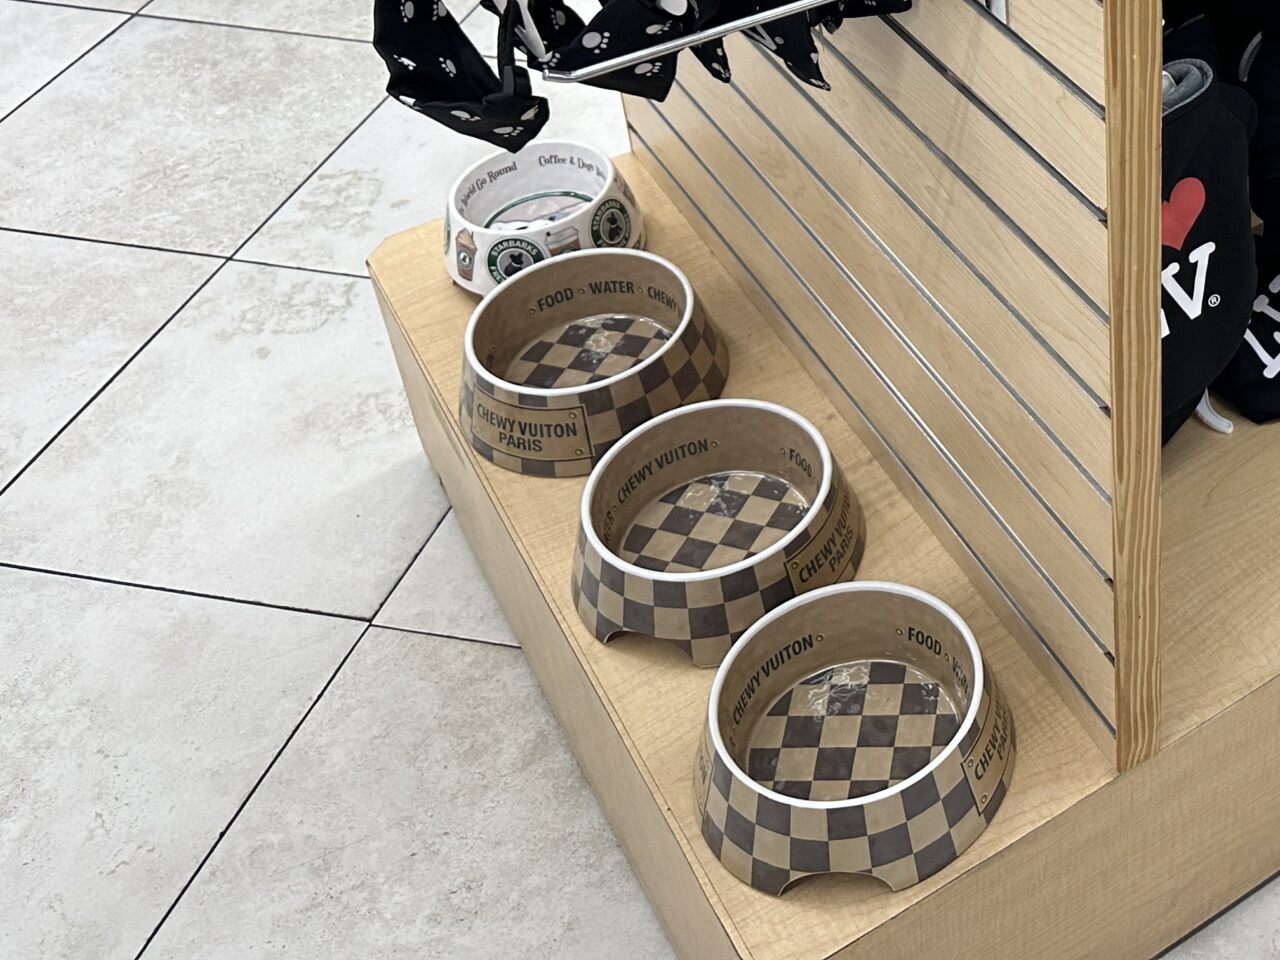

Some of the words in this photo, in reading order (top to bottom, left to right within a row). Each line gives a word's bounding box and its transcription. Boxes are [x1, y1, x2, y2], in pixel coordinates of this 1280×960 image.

[475, 176, 487, 191] Go
[486, 161, 519, 183] Round
[538, 155, 568, 167] Coffee
[490, 239, 539, 258] STARBARKS
[536, 286, 575, 312] FOOD
[588, 280, 635, 303] WATER
[647, 285, 679, 313] CHEWY
[476, 402, 516, 434] CHEWY
[518, 420, 578, 438] VUITON
[498, 430, 543, 453] PARIS
[617, 460, 655, 505] CHEWY
[654, 438, 710, 470] VUITON
[788, 447, 814, 479] FOOD
[798, 533, 838, 585] CHEWY
[827, 525, 854, 573] PARIS
[907, 626, 942, 656] FOOD
[732, 670, 761, 726] CHEWY
[760, 633, 815, 679] VUITON
[974, 718, 1003, 781] CHEWY
